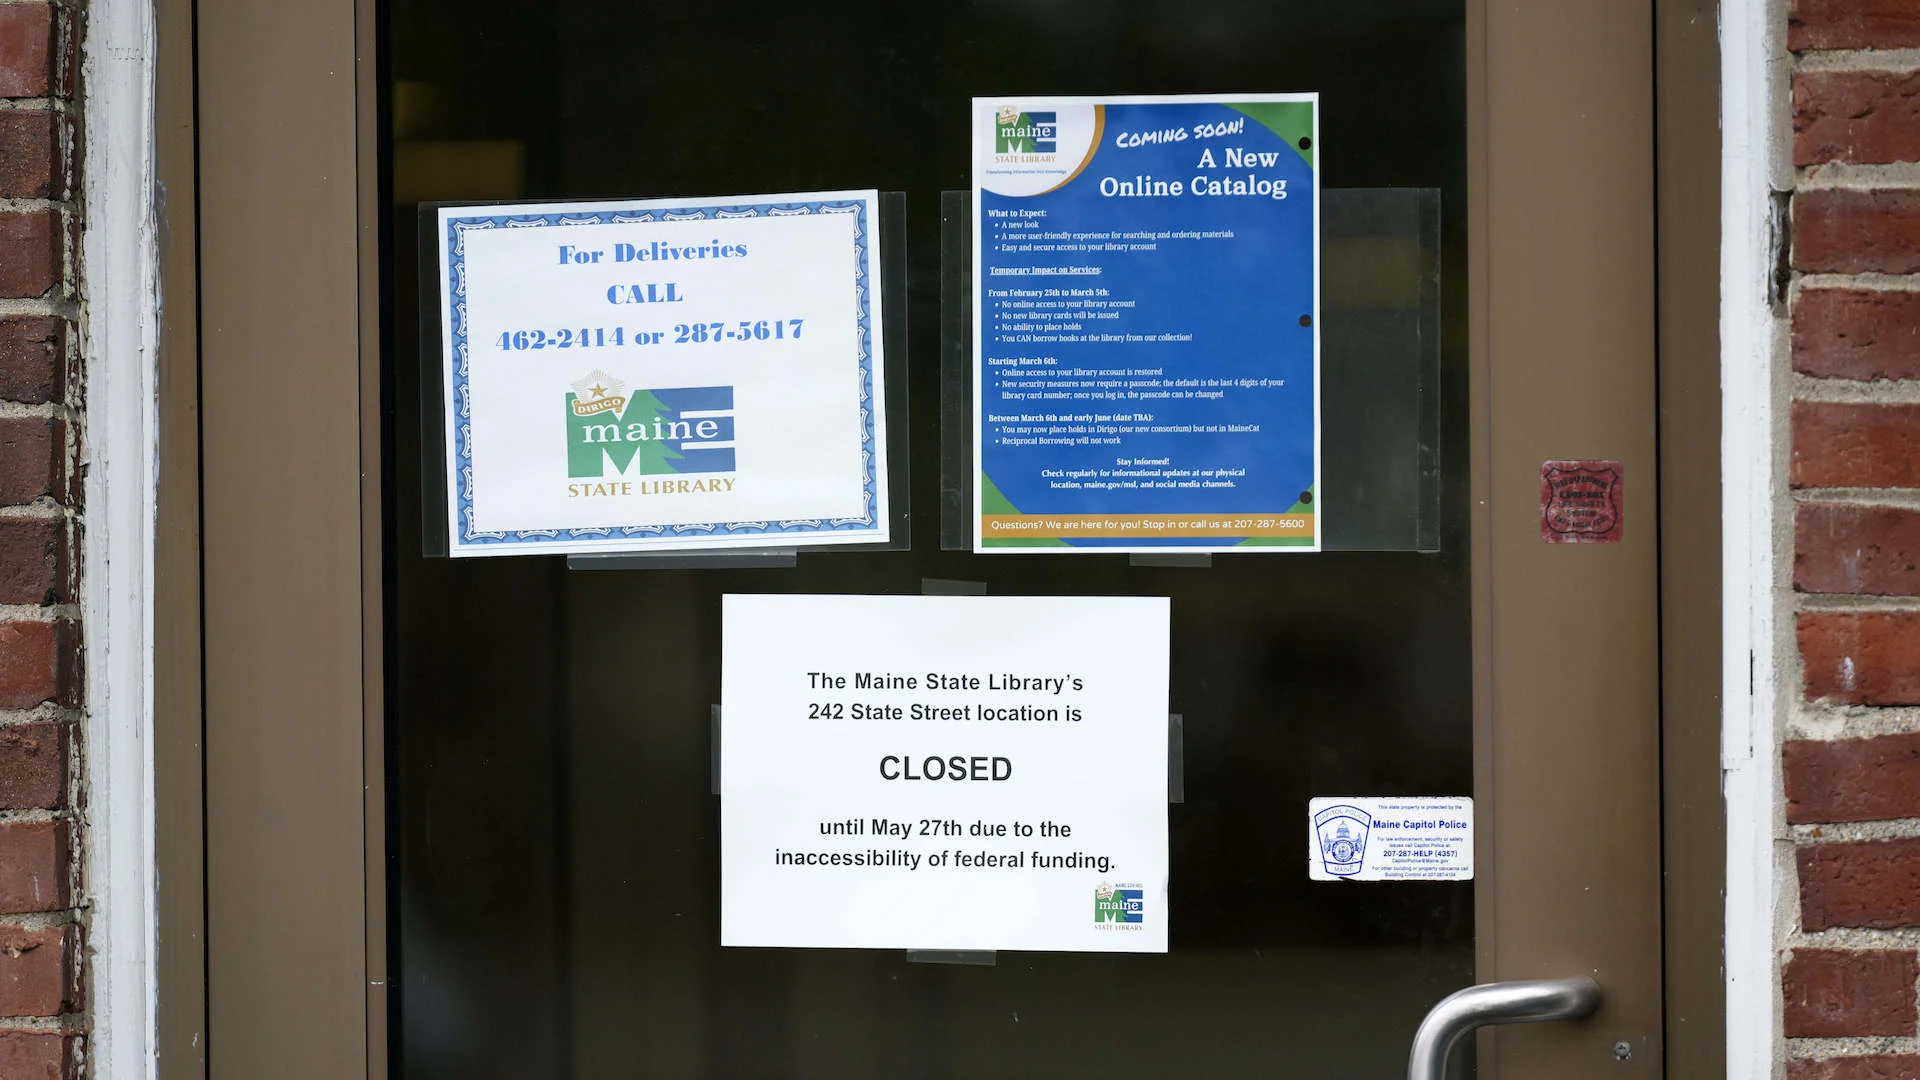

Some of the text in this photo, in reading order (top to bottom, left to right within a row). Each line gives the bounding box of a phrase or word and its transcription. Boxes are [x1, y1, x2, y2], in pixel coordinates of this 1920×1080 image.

[1001, 124, 1051, 138] maine
[1115, 117, 1245, 149] COMING SOON!
[1197, 147, 1279, 168] A New
[1099, 173, 1287, 200] Online Catalog
[988, 209, 1008, 217] What
[1019, 208, 1046, 218] Expect:
[1024, 220, 1039, 228] look
[1001, 232, 1007, 240] A
[1027, 231, 1071, 241] user-friendly
[1072, 231, 1110, 241] experience
[1111, 231, 1121, 239] for
[1123, 230, 1156, 240] searching
[1157, 230, 1170, 238] and
[1171, 230, 1200, 240] ordering
[1202, 230, 1234, 238] materials
[559, 238, 747, 265] For Deliveries
[1001, 243, 1017, 253] Easy
[1018, 243, 1032, 251] and
[1087, 244, 1104, 252] your
[1105, 242, 1128, 252] library
[989, 266, 1030, 274] Temporary
[1032, 266, 1057, 274] Impact
[607, 282, 683, 305] CALL
[988, 289, 1008, 297] From
[1009, 288, 1043, 298] February
[1044, 288, 1060, 296] 25th
[1070, 288, 1094, 296] March
[1095, 288, 1109, 296] 5th:
[1002, 300, 1012, 308] No
[1012, 299, 1034, 308] online
[1066, 301, 1082, 309] your
[1083, 299, 1107, 309] library
[1028, 311, 1052, 321] library
[1053, 311, 1072, 319] cards
[1073, 311, 1086, 319] will
[1087, 311, 1096, 319] be
[1097, 311, 1119, 319] issued
[1001, 323, 1012, 331] No
[1013, 323, 1034, 332] ability
[1044, 322, 1062, 332] place
[1063, 322, 1082, 330] holds
[495, 318, 803, 351] 462-2414 or 287-5617
[988, 357, 1018, 367] Starting
[1019, 357, 1042, 365] March
[577, 398, 622, 415] DIRIGO
[988, 413, 1153, 423] Between March 6th and early June (date TBA):
[583, 416, 719, 444] maine
[1116, 457, 1169, 467] Stay Informed!
[1041, 469, 1064, 477] Check
[1066, 469, 1098, 479] regularly
[1099, 469, 1110, 477] for
[1112, 468, 1161, 476] informational
[1162, 468, 1191, 478] updates
[1215, 468, 1245, 478] physical
[568, 477, 736, 498] STATE LIBRARY
[1139, 480, 1154, 488] and
[1155, 480, 1176, 488] social
[1178, 479, 1200, 488] media
[1201, 479, 1236, 488] channels.
[991, 520, 1043, 530] Questions?
[1045, 520, 1061, 529] We
[1063, 521, 1079, 529] are
[1081, 520, 1102, 528] here
[1104, 519, 1118, 529] for
[1120, 520, 1140, 530] you!
[1142, 519, 1165, 530] Stop
[1167, 519, 1176, 528] in
[1190, 519, 1206, 528] call
[1234, 519, 1304, 528] 207-287-5600
[807, 672, 846, 689] The
[855, 672, 917, 689] Maine
[926, 673, 980, 690] State
[808, 703, 1082, 722] 242 State Street location is
[879, 755, 1012, 781] CLOSED
[1317, 808, 1367, 822] CAPITOL POLICE
[820, 818, 1071, 840] until May 27th due to the
[1373, 820, 1467, 830] Maine Capitol Police
[776, 848, 1114, 873] inaccessibility of federal funding.
[1099, 900, 1139, 910] maine
